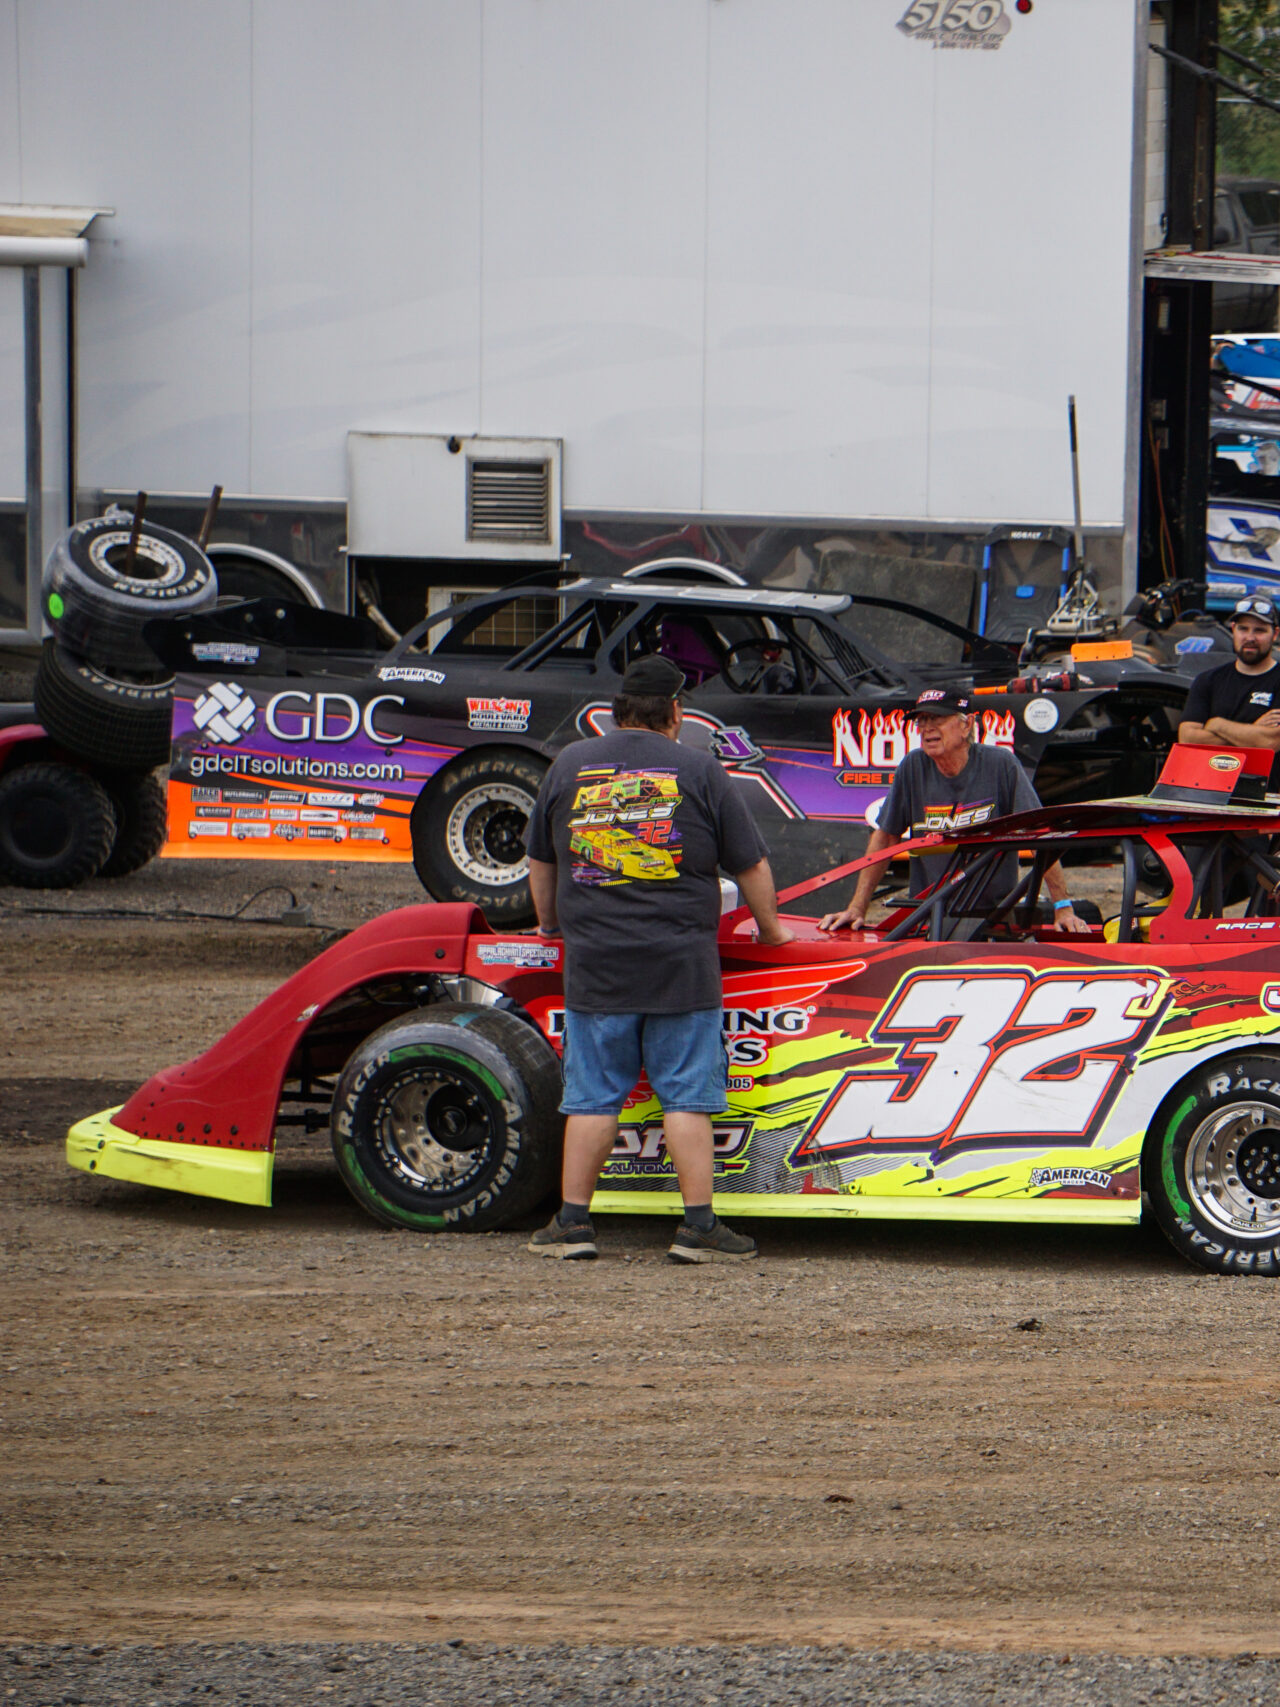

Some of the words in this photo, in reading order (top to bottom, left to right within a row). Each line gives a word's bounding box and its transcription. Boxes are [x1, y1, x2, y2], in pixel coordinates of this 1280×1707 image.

[112, 569, 207, 598] AMERICAN
[78, 667, 175, 698] MERICAN
[384, 669, 443, 682] AMERICAN
[265, 690, 404, 744] GDC
[468, 699, 530, 717] WILSON'S
[190, 754, 403, 782] gdcITsolutions.com
[442, 759, 541, 794] AMERICA
[843, 772, 881, 785] FIRE
[638, 820, 673, 845] 32
[1215, 921, 1275, 930] RACE
[797, 973, 1162, 1157] 32
[338, 1050, 392, 1138] RACER
[443, 1098, 524, 1224] AMERICAN
[1039, 1168, 1110, 1187] AMERICAN
